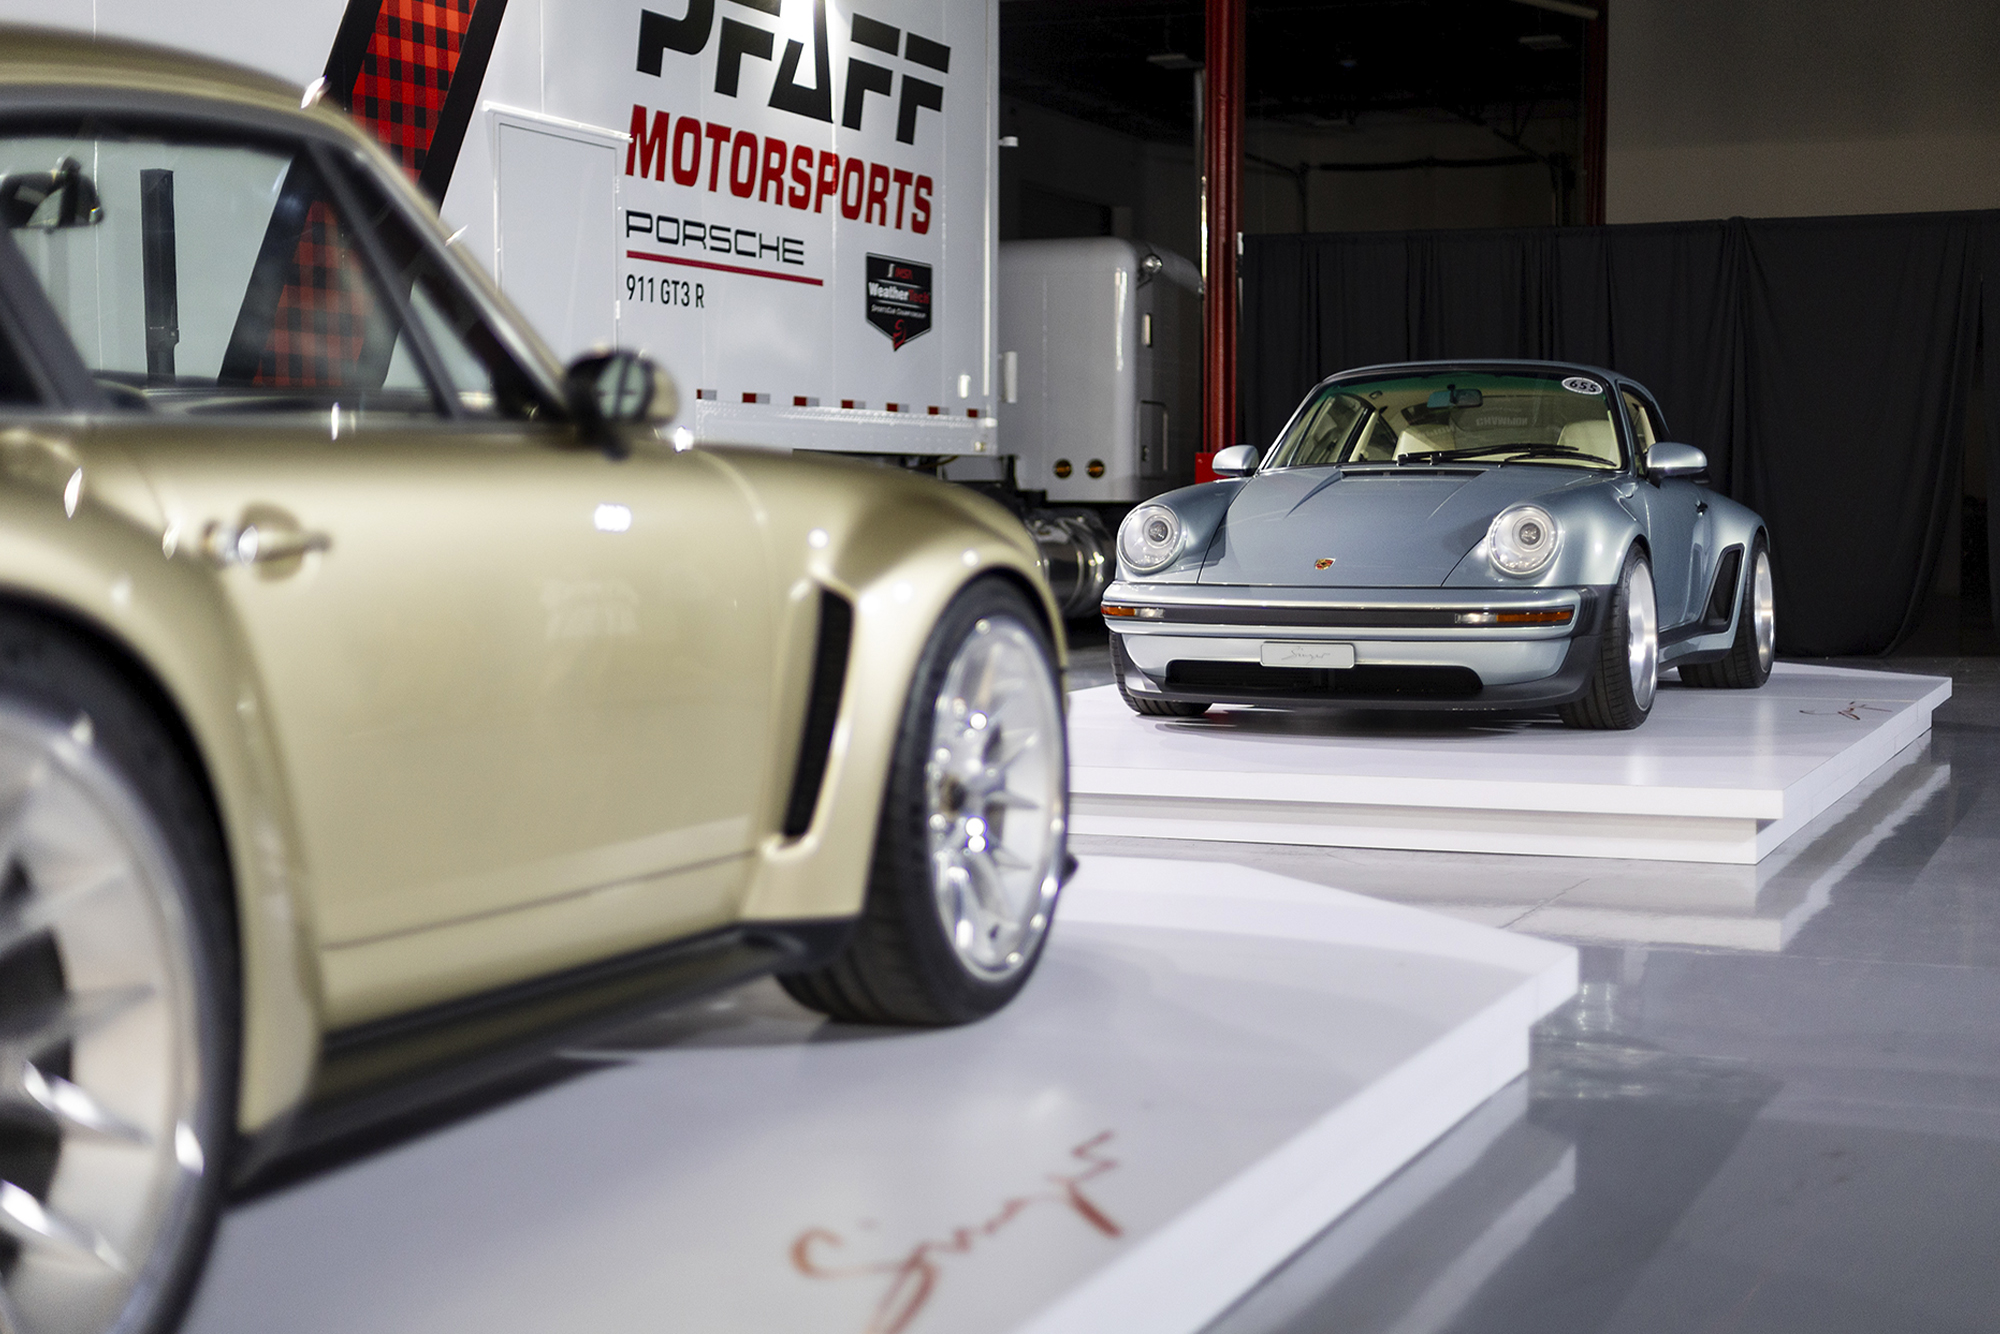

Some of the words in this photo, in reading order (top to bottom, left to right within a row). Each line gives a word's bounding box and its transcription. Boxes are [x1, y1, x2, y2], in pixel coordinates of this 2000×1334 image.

[636, 0, 951, 145] PFAFF
[625, 103, 933, 235] MOTORSPORTS
[625, 209, 805, 266] PORSCHE
[626, 273, 655, 304] 911
[660, 279, 690, 308] GT3
[695, 283, 705, 309] R
[1569, 379, 1598, 393] 655
